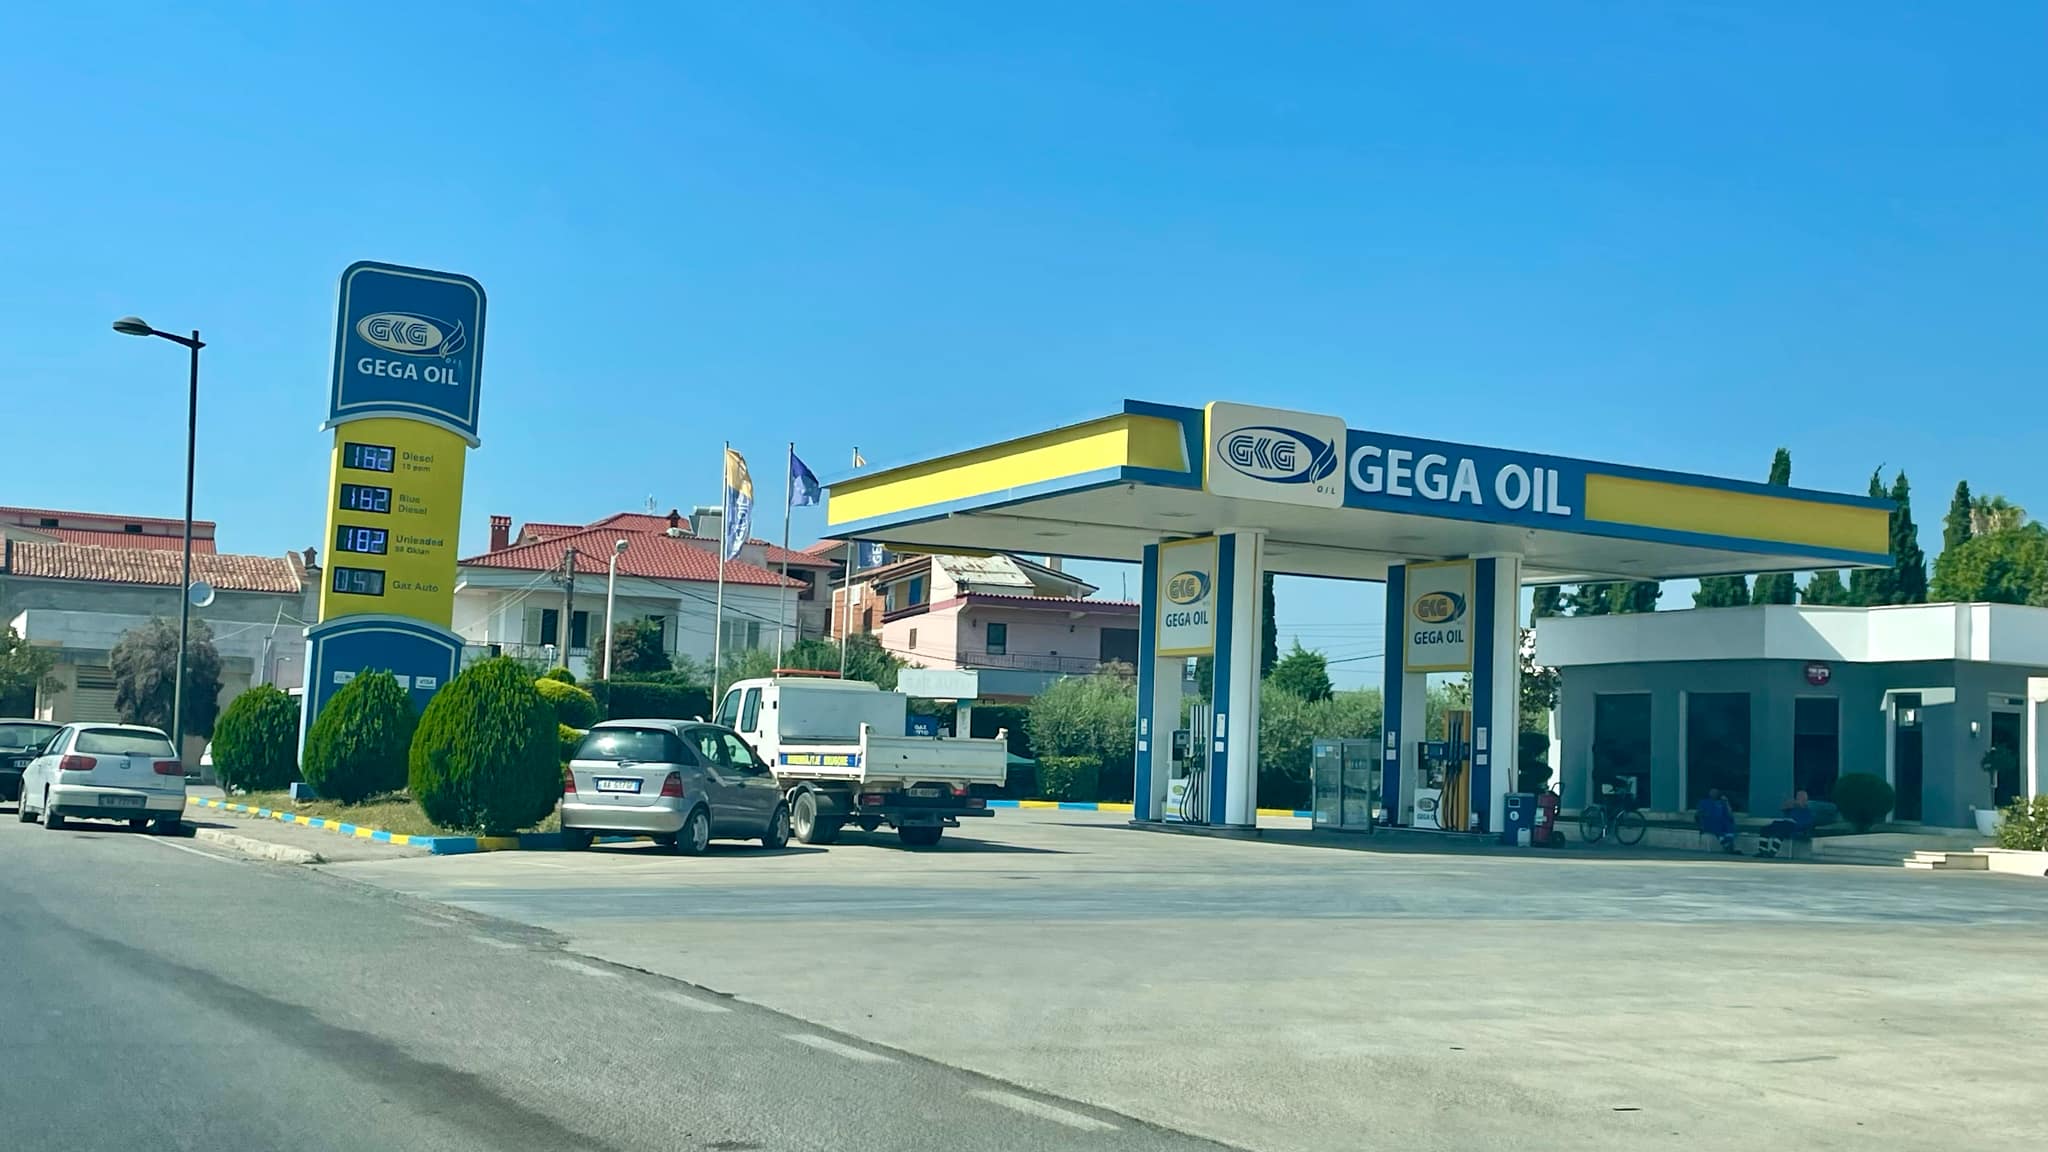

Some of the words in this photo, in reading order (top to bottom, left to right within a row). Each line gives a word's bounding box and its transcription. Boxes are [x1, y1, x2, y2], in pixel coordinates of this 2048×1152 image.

[357, 357, 418, 381] GEGA
[424, 366, 459, 386] OIL
[402, 450, 434, 464] Diesel
[1348, 444, 1483, 505] GEGA
[1494, 463, 1571, 516] OIL
[1316, 485, 1336, 496] OIL
[398, 504, 428, 515] Diesel
[396, 534, 444, 548] Unleaded
[392, 579, 411, 591] Gaz
[413, 581, 439, 593] Auto
[1165, 611, 1191, 628] GEGA
[1193, 610, 1209, 626] OIL
[1414, 630, 1443, 645] GEGA
[1446, 629, 1464, 644] OIL
